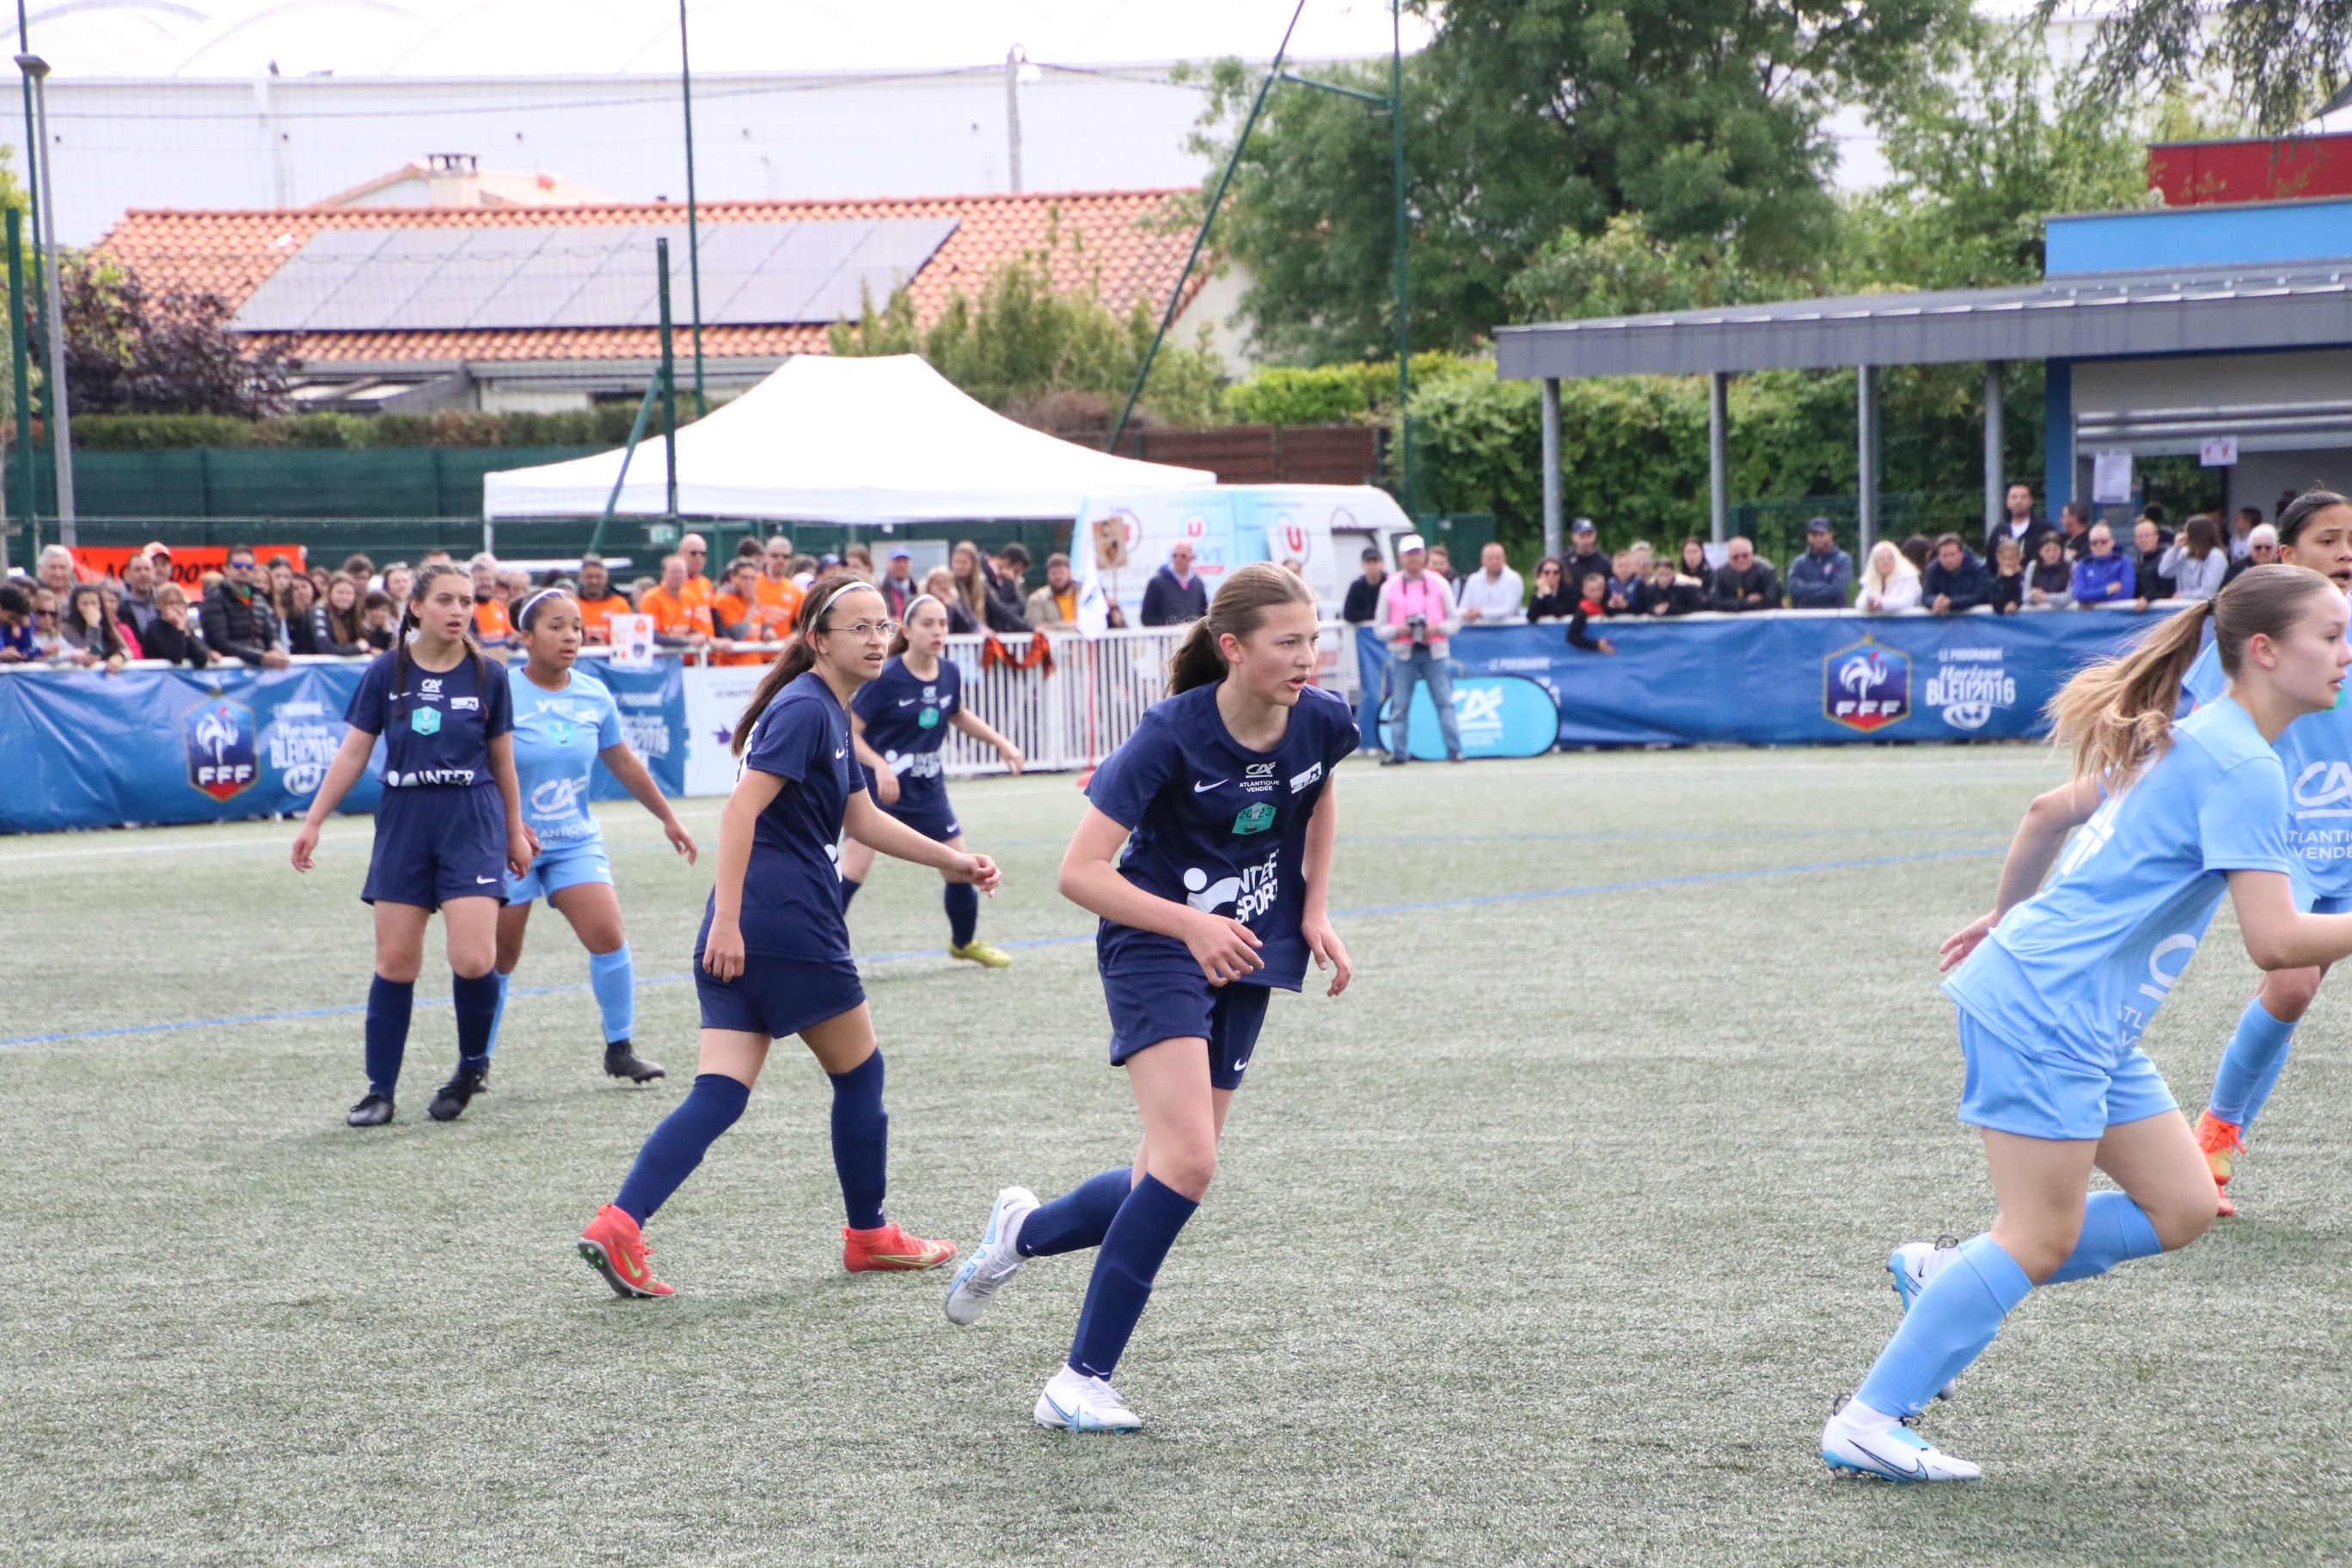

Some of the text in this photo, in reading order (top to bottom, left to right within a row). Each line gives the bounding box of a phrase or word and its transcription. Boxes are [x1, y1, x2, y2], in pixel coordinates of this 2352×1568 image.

[1835, 700, 1902, 718] FFF
[198, 763, 253, 786] FFF
[1239, 780, 1280, 788] ATLANTIQUE
[2288, 830, 2352, 844] TLANTI
